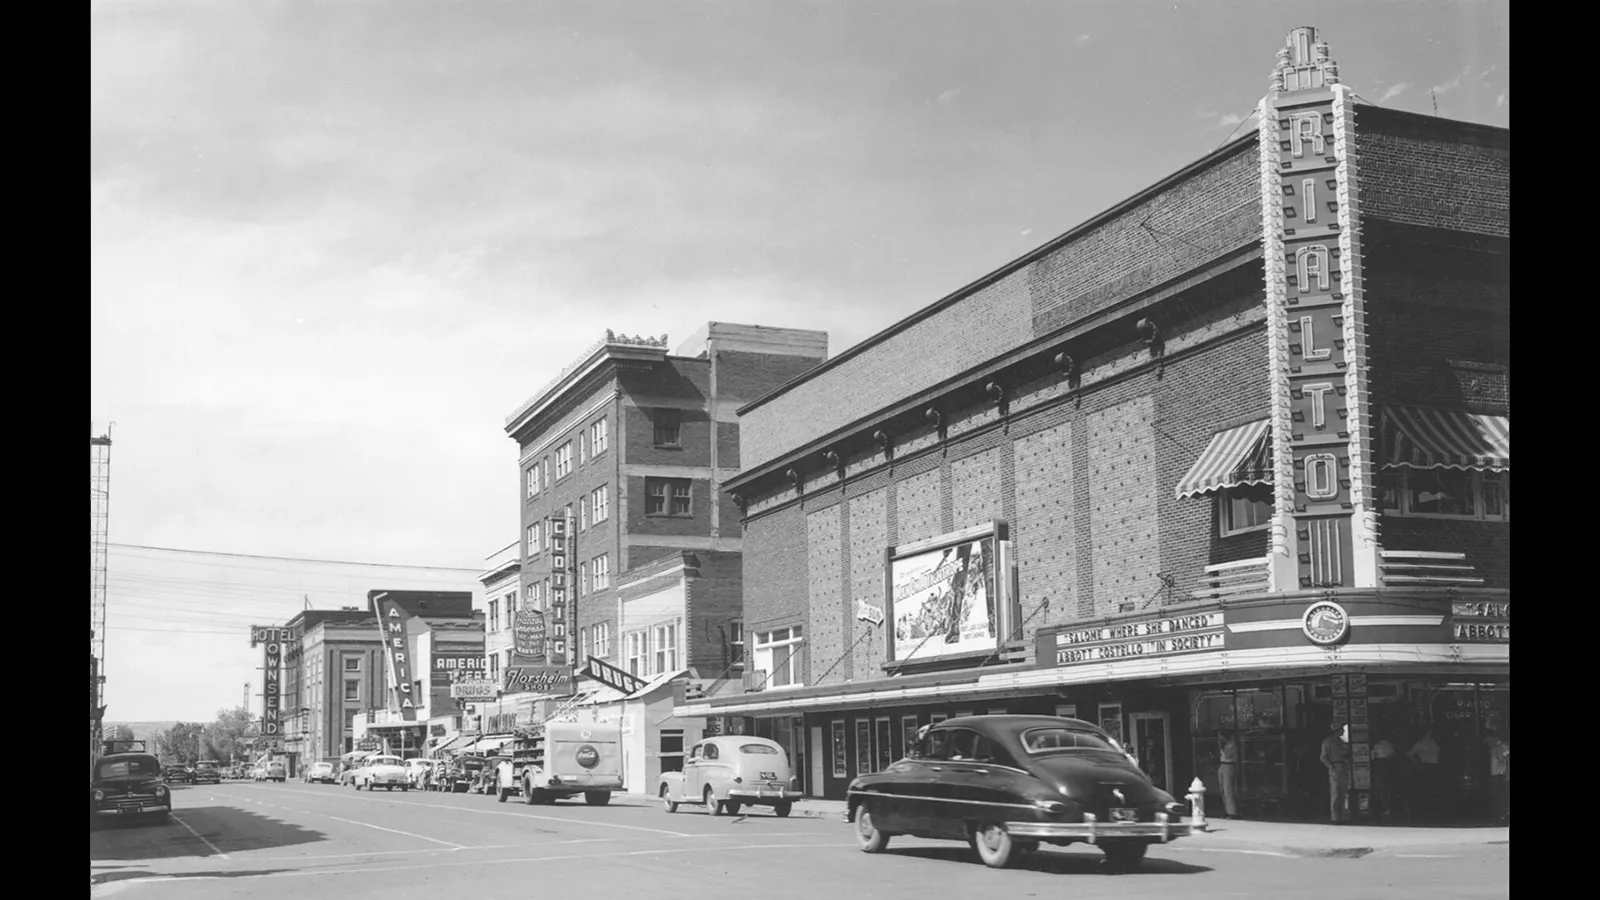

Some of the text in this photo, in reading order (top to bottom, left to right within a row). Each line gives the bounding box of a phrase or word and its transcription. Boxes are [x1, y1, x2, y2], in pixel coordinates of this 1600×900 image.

[1288, 111, 1339, 501] RIALTO
[554, 521, 565, 654] CLOTHING
[251, 628, 295, 642] HOTEL
[1109, 624, 1138, 639] WHERE
[1146, 622, 1162, 635] SHE
[388, 607, 414, 708] AMERICA
[1059, 649, 1093, 662] ABBOTT
[1099, 643, 1143, 659] COSTELLO
[507, 668, 568, 690] Florsheim
[590, 660, 643, 692] DRUGS
[455, 686, 491, 696] DRUGS
